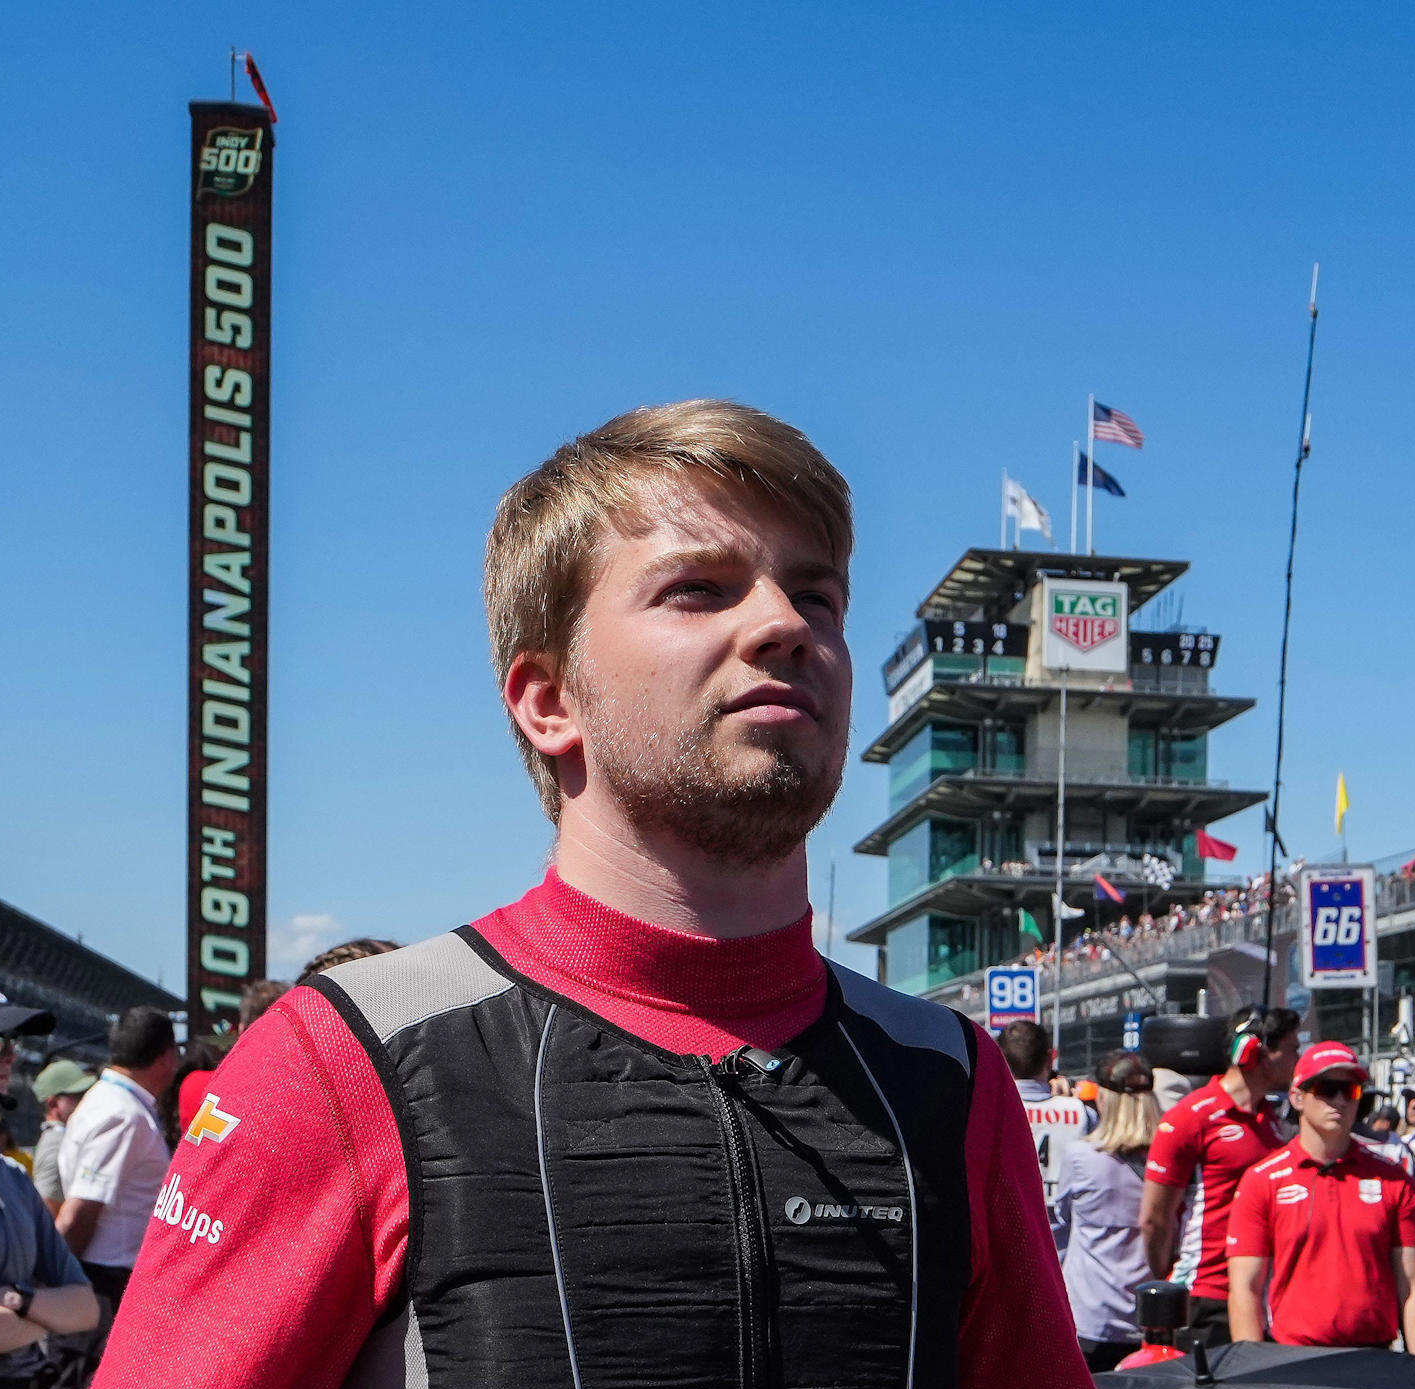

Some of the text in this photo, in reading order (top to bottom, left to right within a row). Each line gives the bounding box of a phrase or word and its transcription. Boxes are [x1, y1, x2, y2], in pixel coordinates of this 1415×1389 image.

[215, 135, 250, 149] INDY
[199, 147, 258, 175] 500
[203, 221, 254, 351] 500
[201, 363, 253, 812] INDIANAPOLIS
[1058, 594, 1115, 617] TAG
[1054, 616, 1120, 651] HEUER
[200, 826, 251, 1013] 109TH
[1312, 906, 1362, 946] 66
[990, 975, 1035, 1010] 98
[181, 1205, 224, 1244] ups
[814, 1203, 904, 1222] INUTEQ
